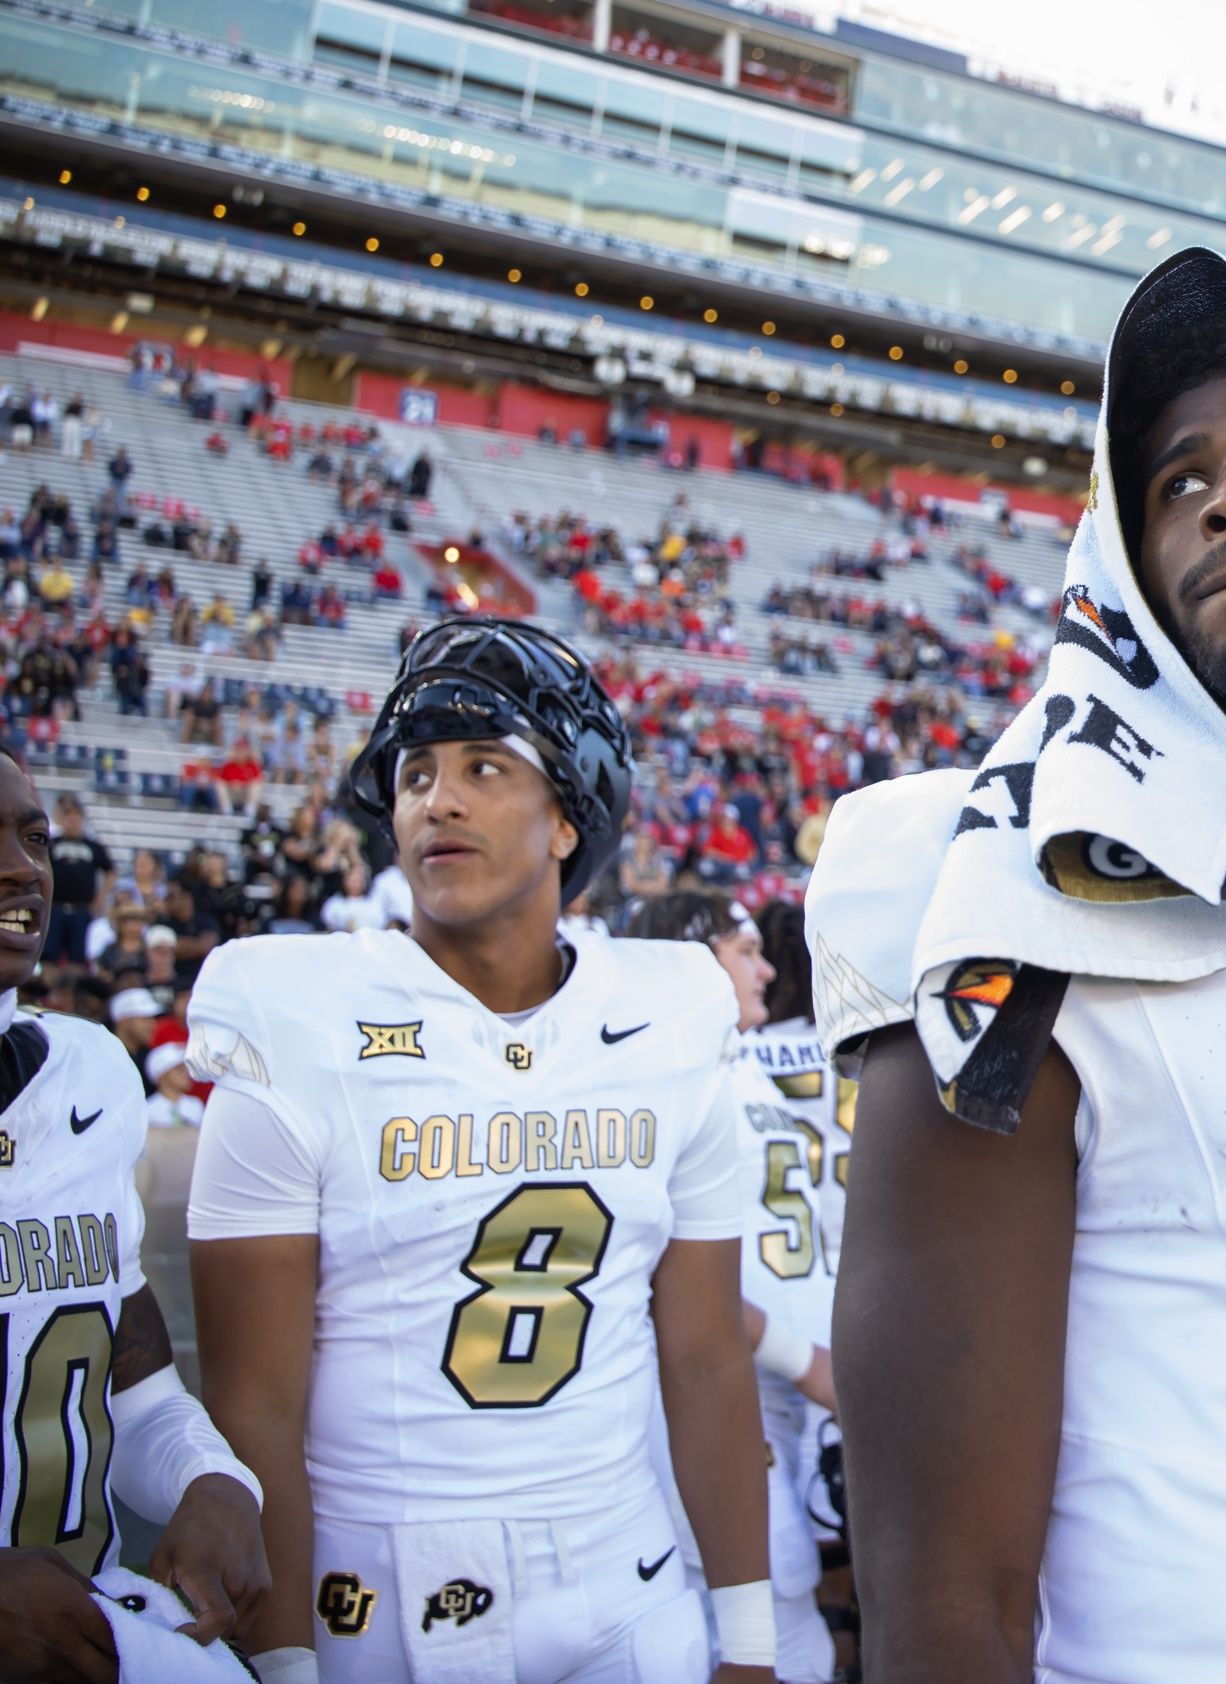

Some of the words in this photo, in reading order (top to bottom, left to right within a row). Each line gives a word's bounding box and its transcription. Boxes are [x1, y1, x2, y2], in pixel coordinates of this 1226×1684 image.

[356, 1020, 426, 1060] XII
[505, 1043, 532, 1070] CU
[379, 1108, 657, 1182] COLORADO
[440, 1181, 615, 1409] 8
[314, 1571, 378, 1639] CU
[439, 1584, 475, 1617] CU
